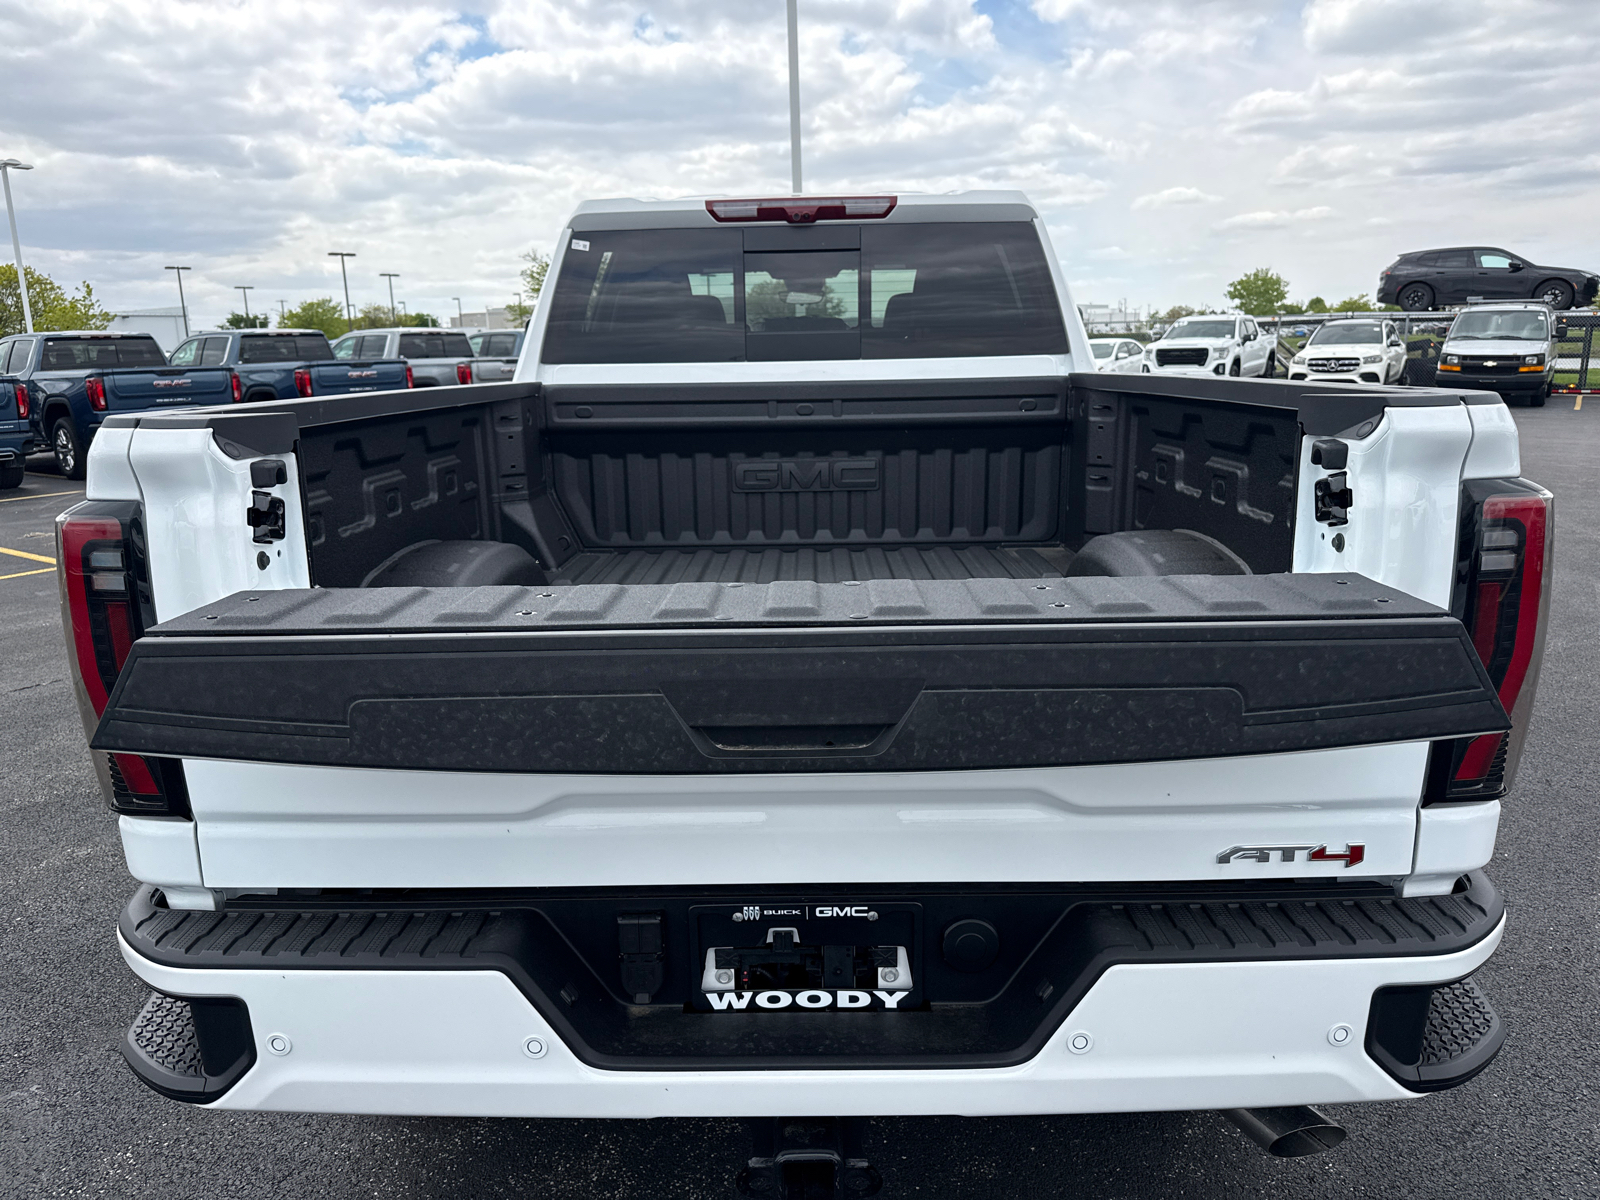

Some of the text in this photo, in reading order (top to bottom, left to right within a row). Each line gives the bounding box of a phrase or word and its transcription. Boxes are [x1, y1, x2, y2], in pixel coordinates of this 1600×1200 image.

[735, 461, 877, 490] GMC
[1216, 842, 1365, 868] AT4
[815, 906, 869, 917] GMC
[705, 990, 910, 1010] WOODY
